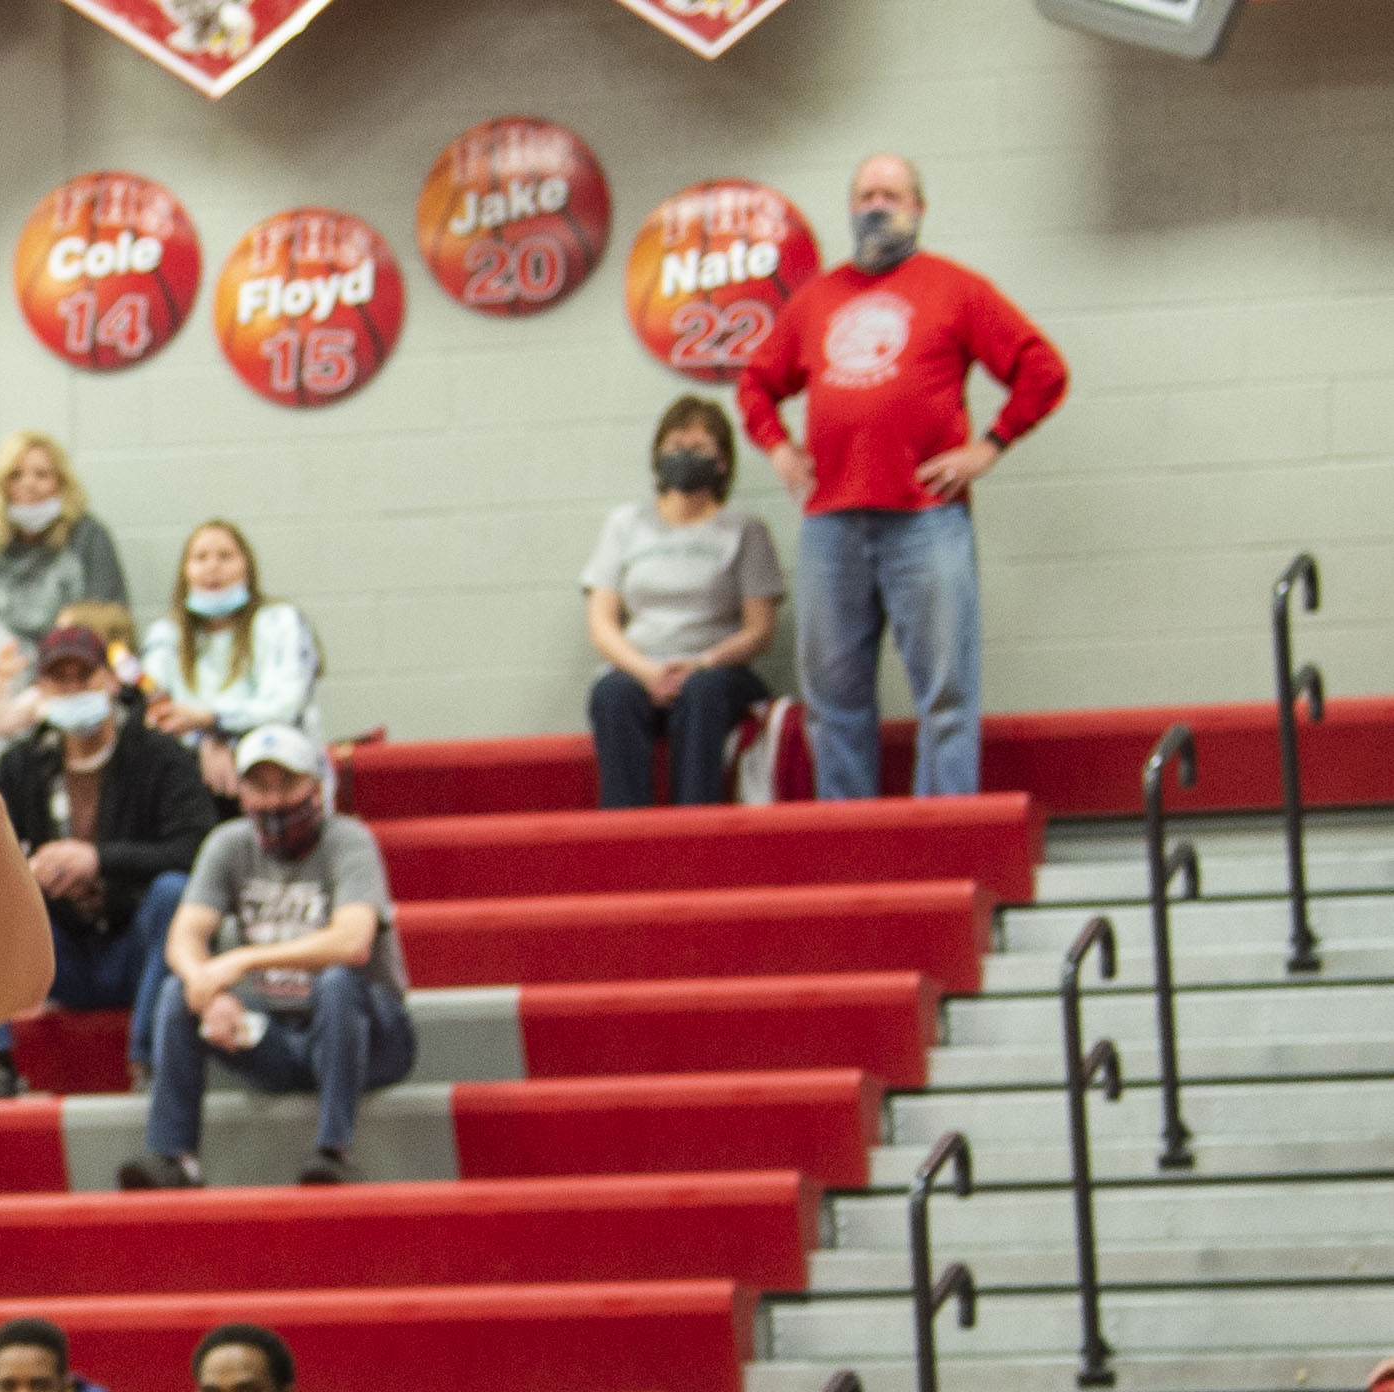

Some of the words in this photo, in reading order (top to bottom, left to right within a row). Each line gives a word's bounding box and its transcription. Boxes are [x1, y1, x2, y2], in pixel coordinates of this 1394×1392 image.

[450, 177, 569, 235] Jake
[48, 232, 162, 281] Cole
[463, 238, 566, 302] 20
[661, 239, 779, 297] Nate
[58, 290, 154, 358] 14
[236, 259, 376, 325] Floyd
[261, 328, 357, 394] 15
[671, 301, 774, 368] 22
